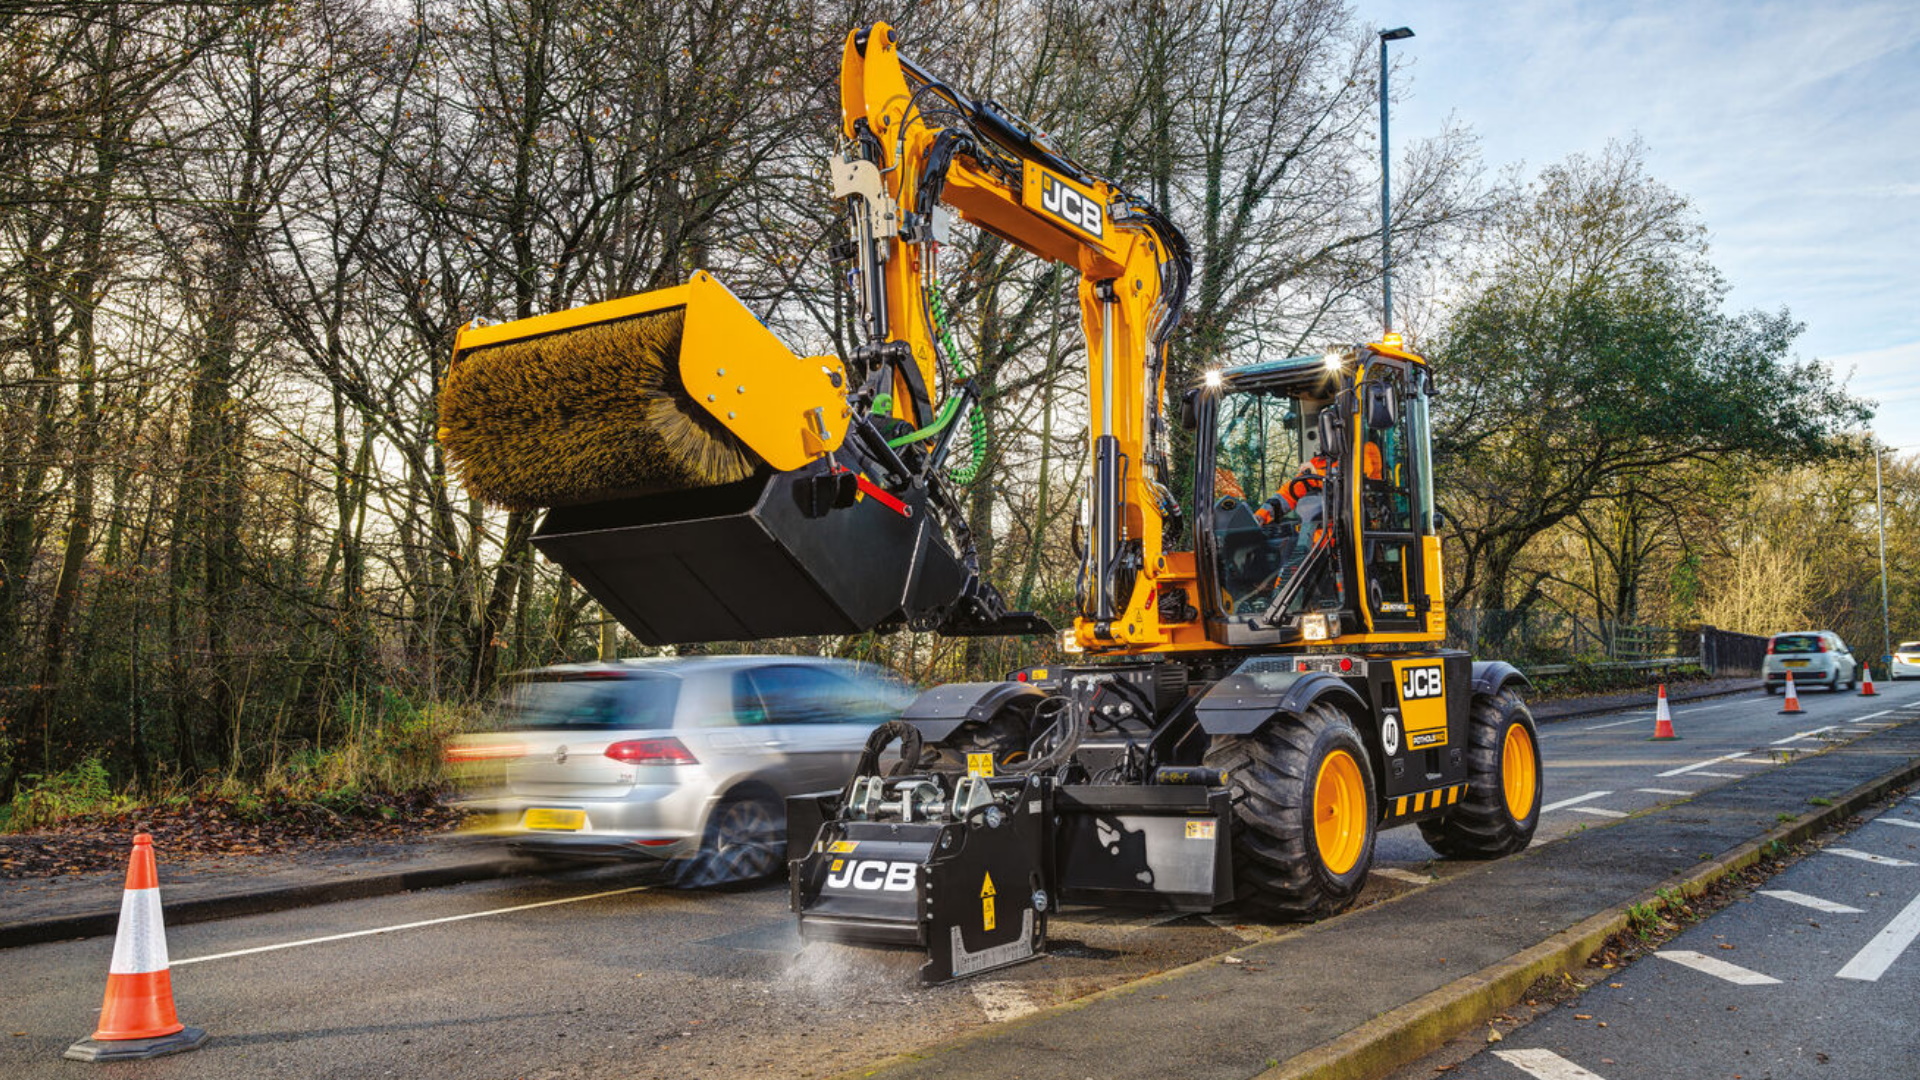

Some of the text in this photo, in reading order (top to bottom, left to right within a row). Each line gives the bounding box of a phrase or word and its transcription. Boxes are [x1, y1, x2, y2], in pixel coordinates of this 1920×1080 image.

[1043, 181, 1102, 236] JCB
[1403, 668, 1442, 698] JCB
[1386, 722, 1396, 747] 40
[827, 860, 918, 891] JCB
